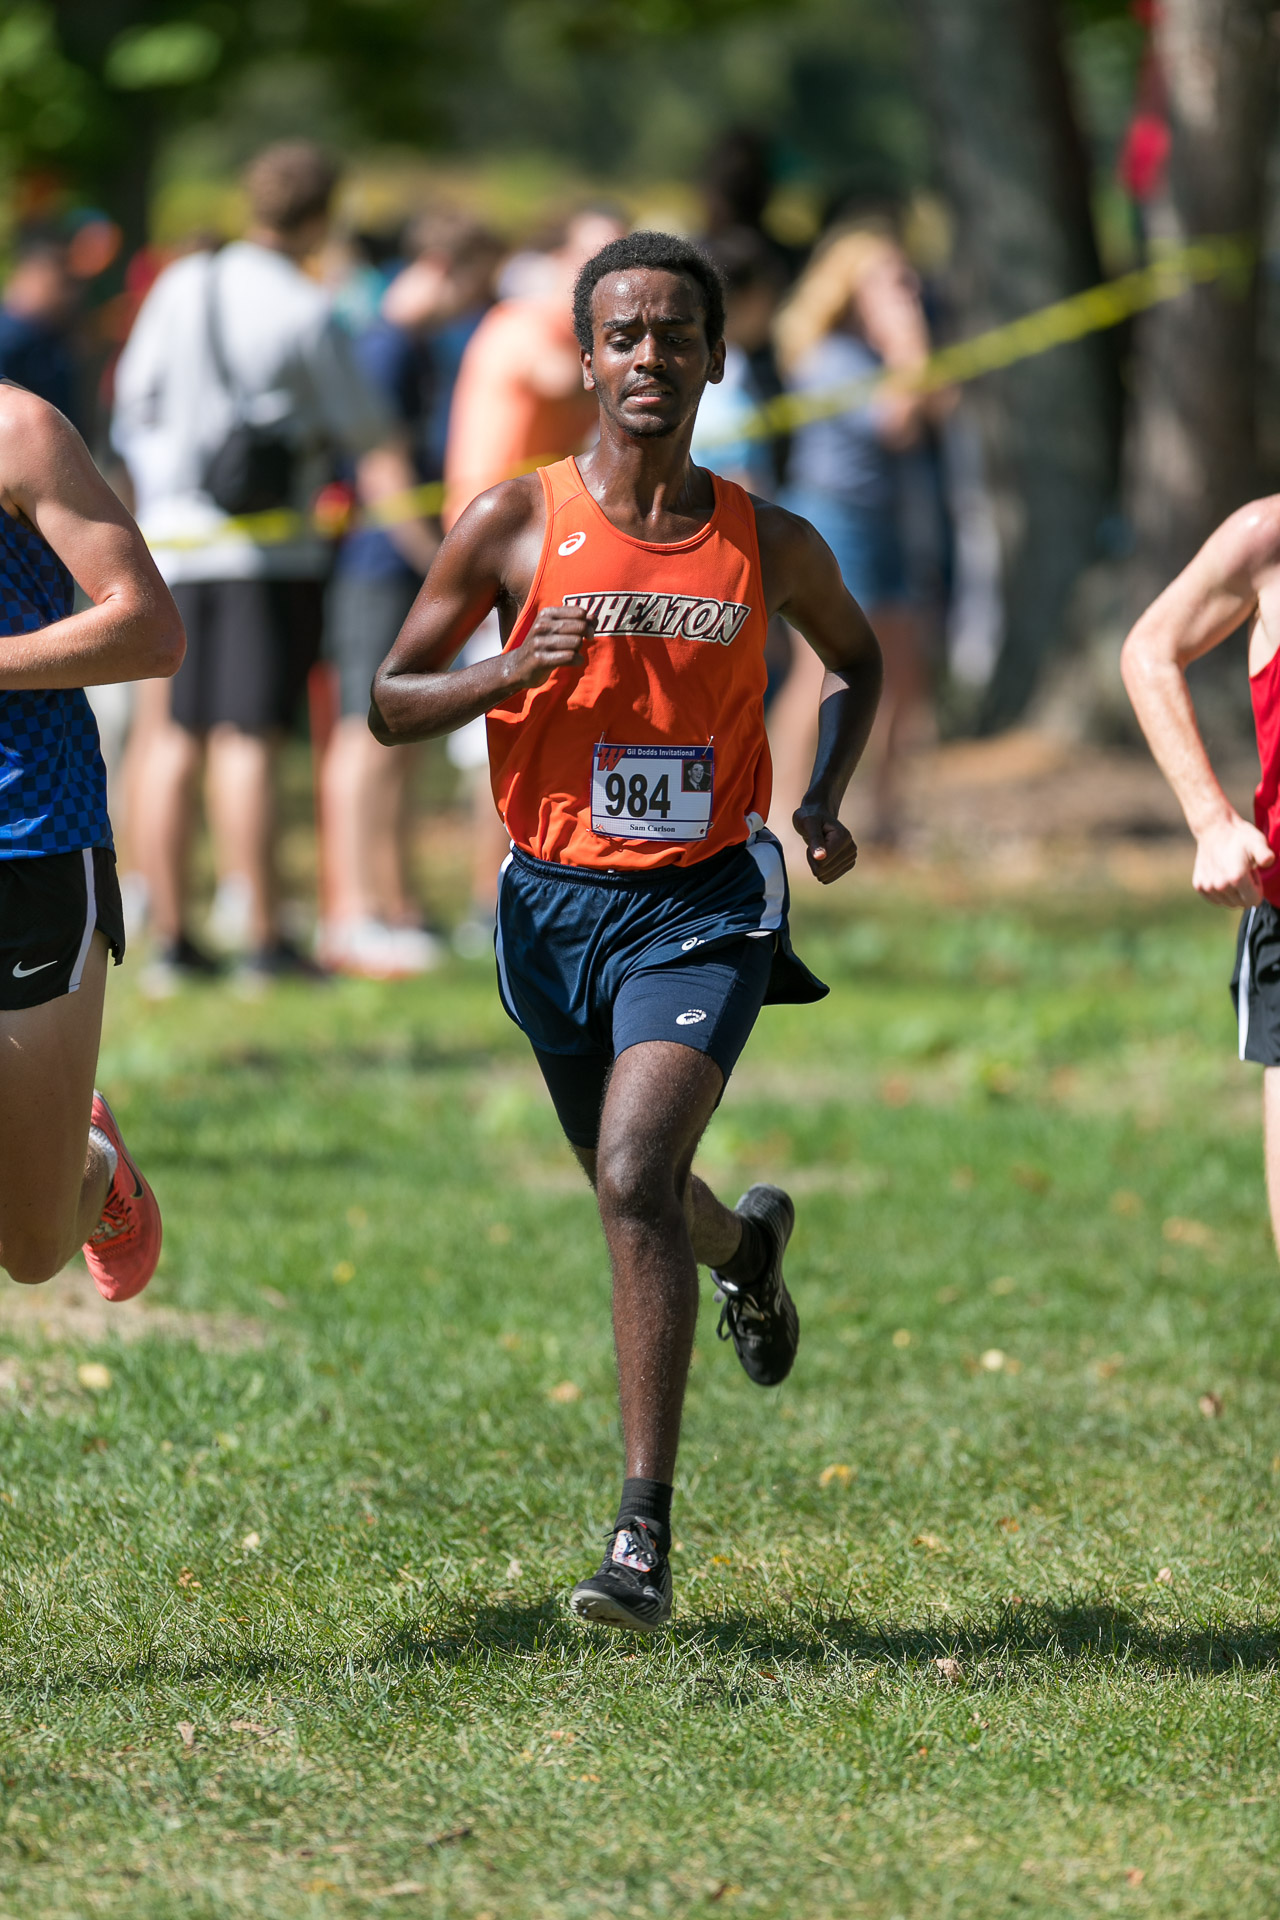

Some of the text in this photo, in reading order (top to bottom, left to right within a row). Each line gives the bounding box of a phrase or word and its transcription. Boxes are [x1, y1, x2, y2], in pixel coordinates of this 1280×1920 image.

[597, 748, 626, 771] W
[626, 748, 695, 757] Gil Dodds Invitational
[605, 773, 671, 818] 984
[647, 825, 676, 833] Carlson
